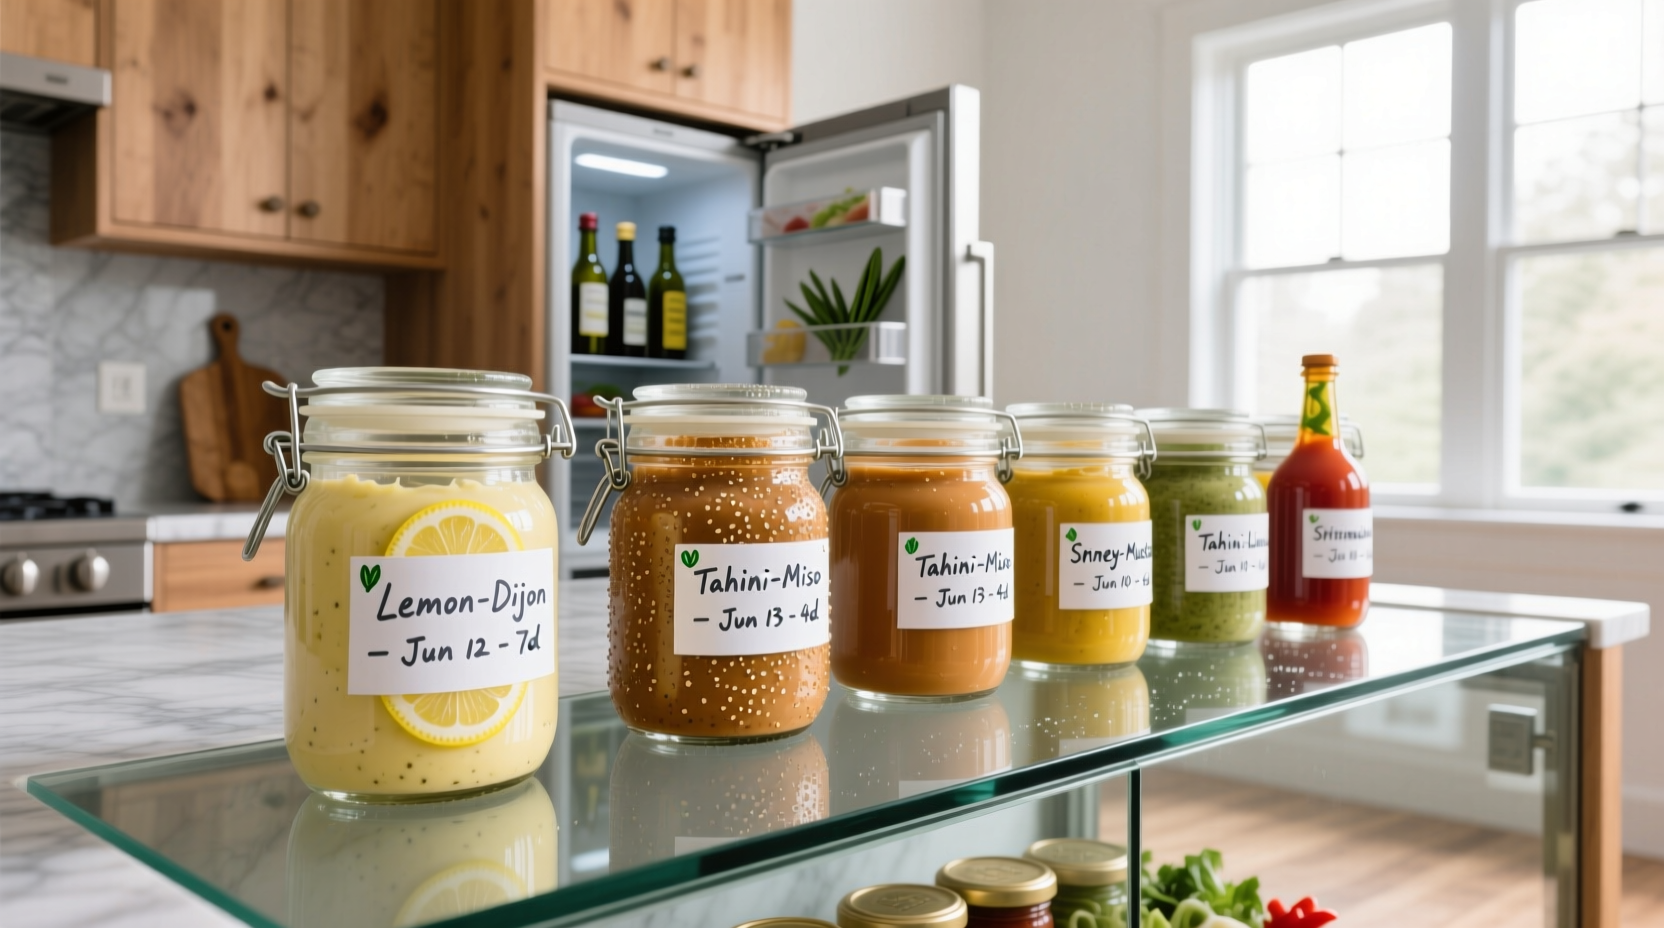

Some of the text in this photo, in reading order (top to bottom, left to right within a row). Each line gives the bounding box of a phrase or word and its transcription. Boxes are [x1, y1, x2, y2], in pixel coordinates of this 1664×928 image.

[693, 563, 821, 595] Tahini-Miso
[1092, 575, 1117, 591] Jun
[376, 579, 546, 622] Lemon-Dijon
[936, 588, 967, 608] Jun
[972, 586, 985, 604] 13
[719, 607, 758, 632] Jun
[766, 606, 784, 628] 13
[800, 597, 820, 623] 4d
[401, 635, 453, 667] Jun
[466, 637, 491, 660] 12
[515, 623, 542, 656] 7d
